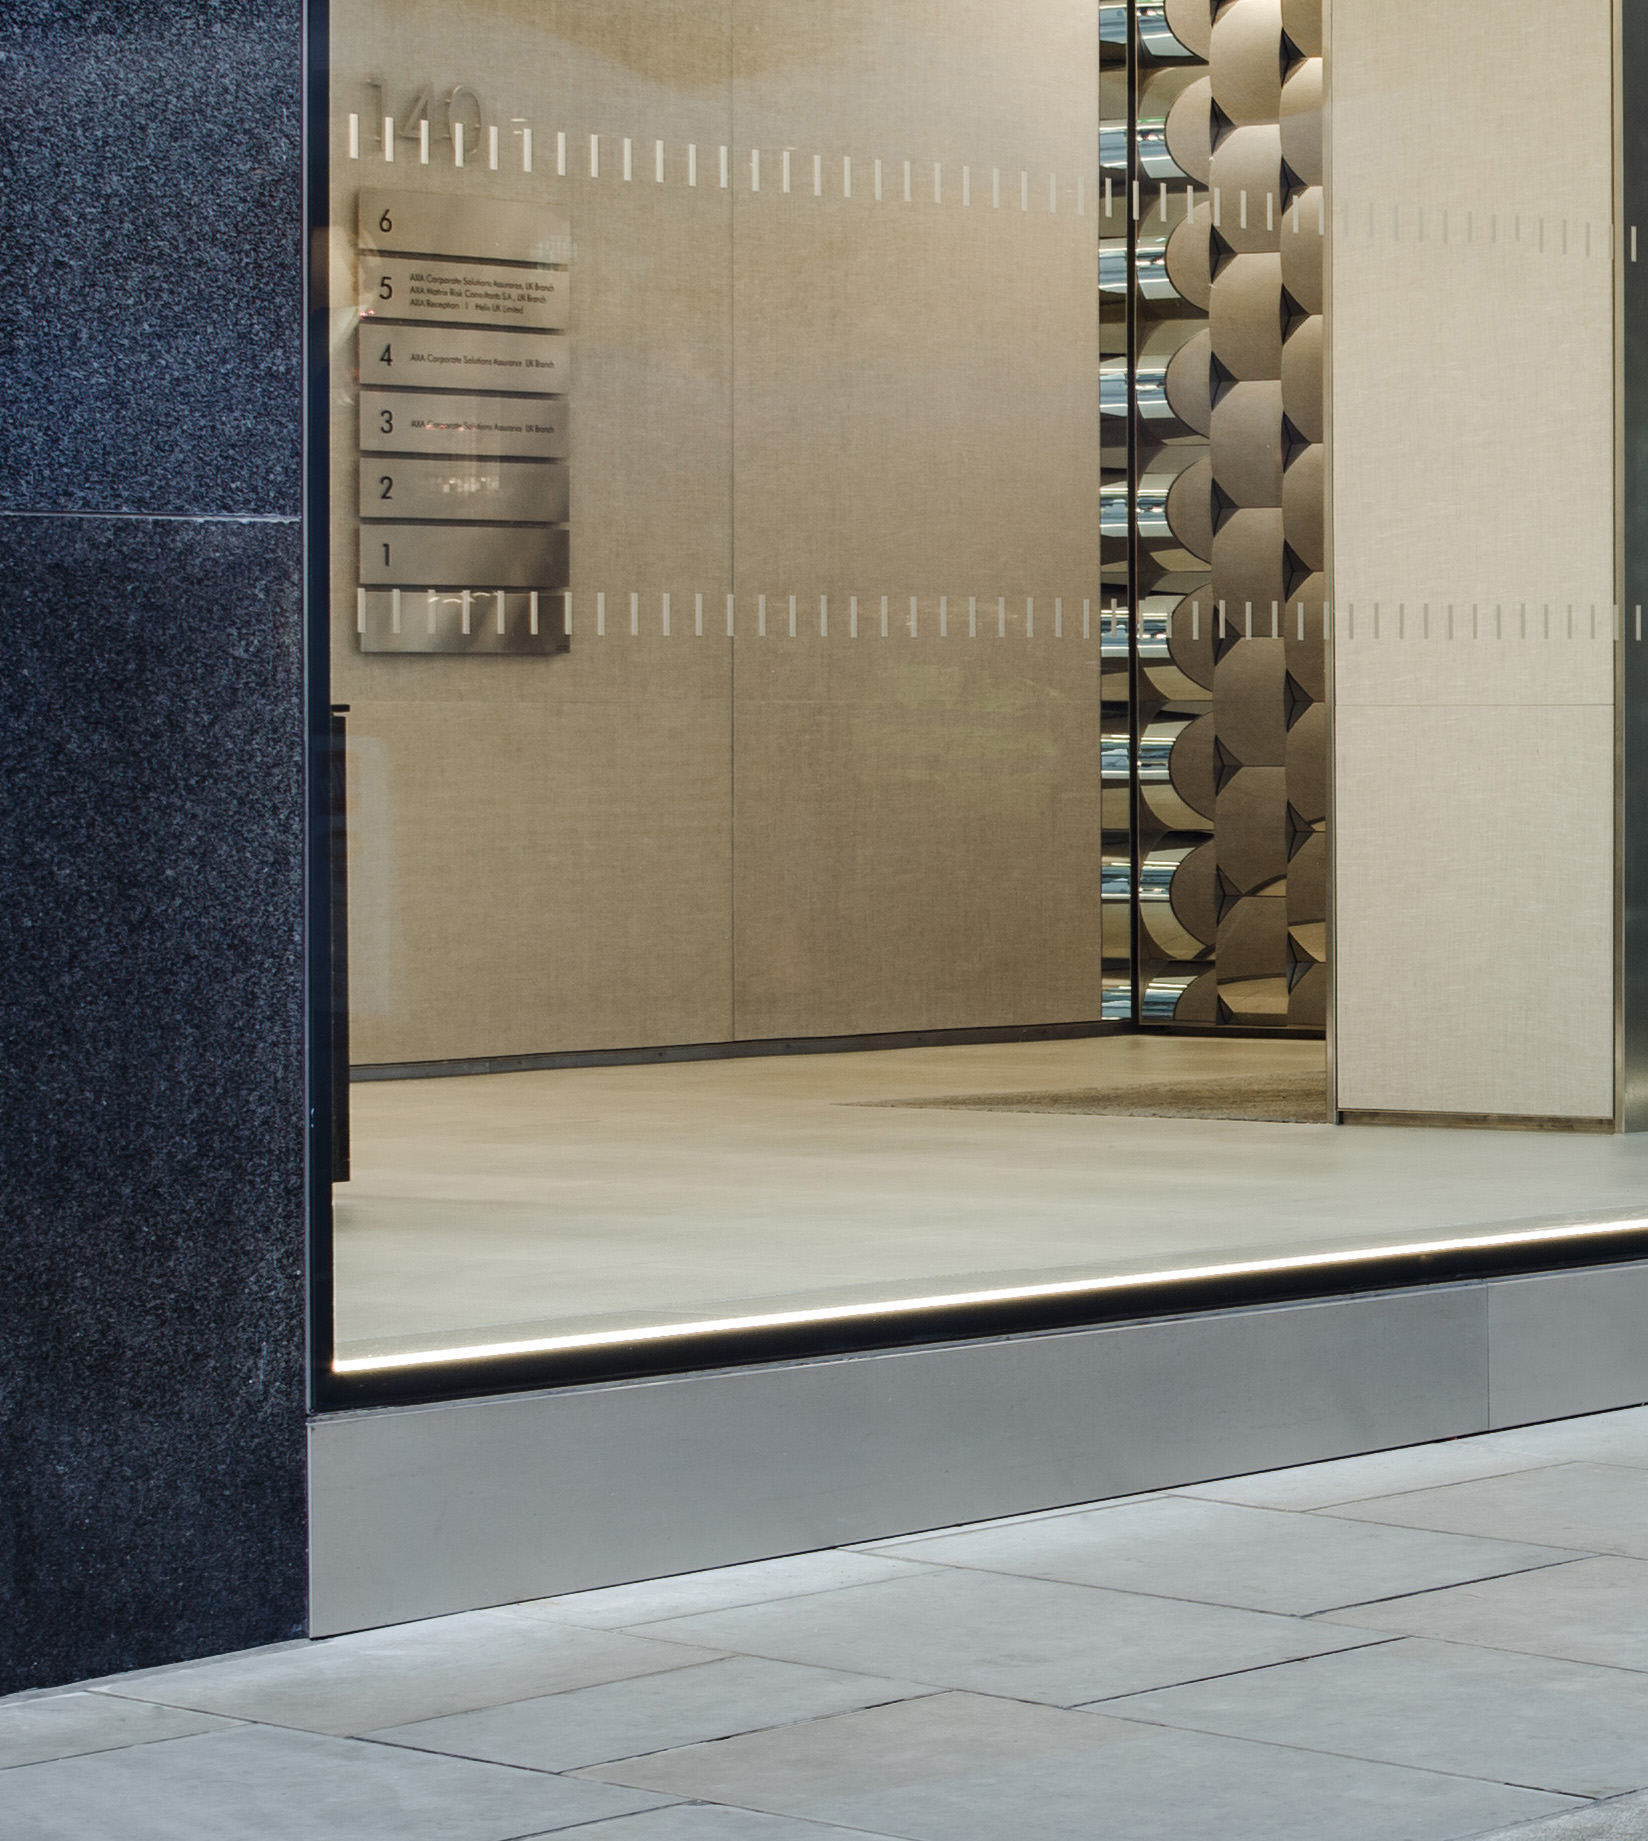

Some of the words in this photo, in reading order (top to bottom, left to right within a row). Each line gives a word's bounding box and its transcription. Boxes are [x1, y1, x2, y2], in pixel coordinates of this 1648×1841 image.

[366, 78, 482, 156] 140
[379, 209, 392, 233] 6
[379, 276, 393, 300] 5
[426, 274, 461, 285] Corporate
[463, 276, 492, 287] Solutions
[379, 343, 393, 367] 4
[380, 410, 393, 434] 3
[379, 476, 393, 499] 2
[383, 543, 390, 567] 1
